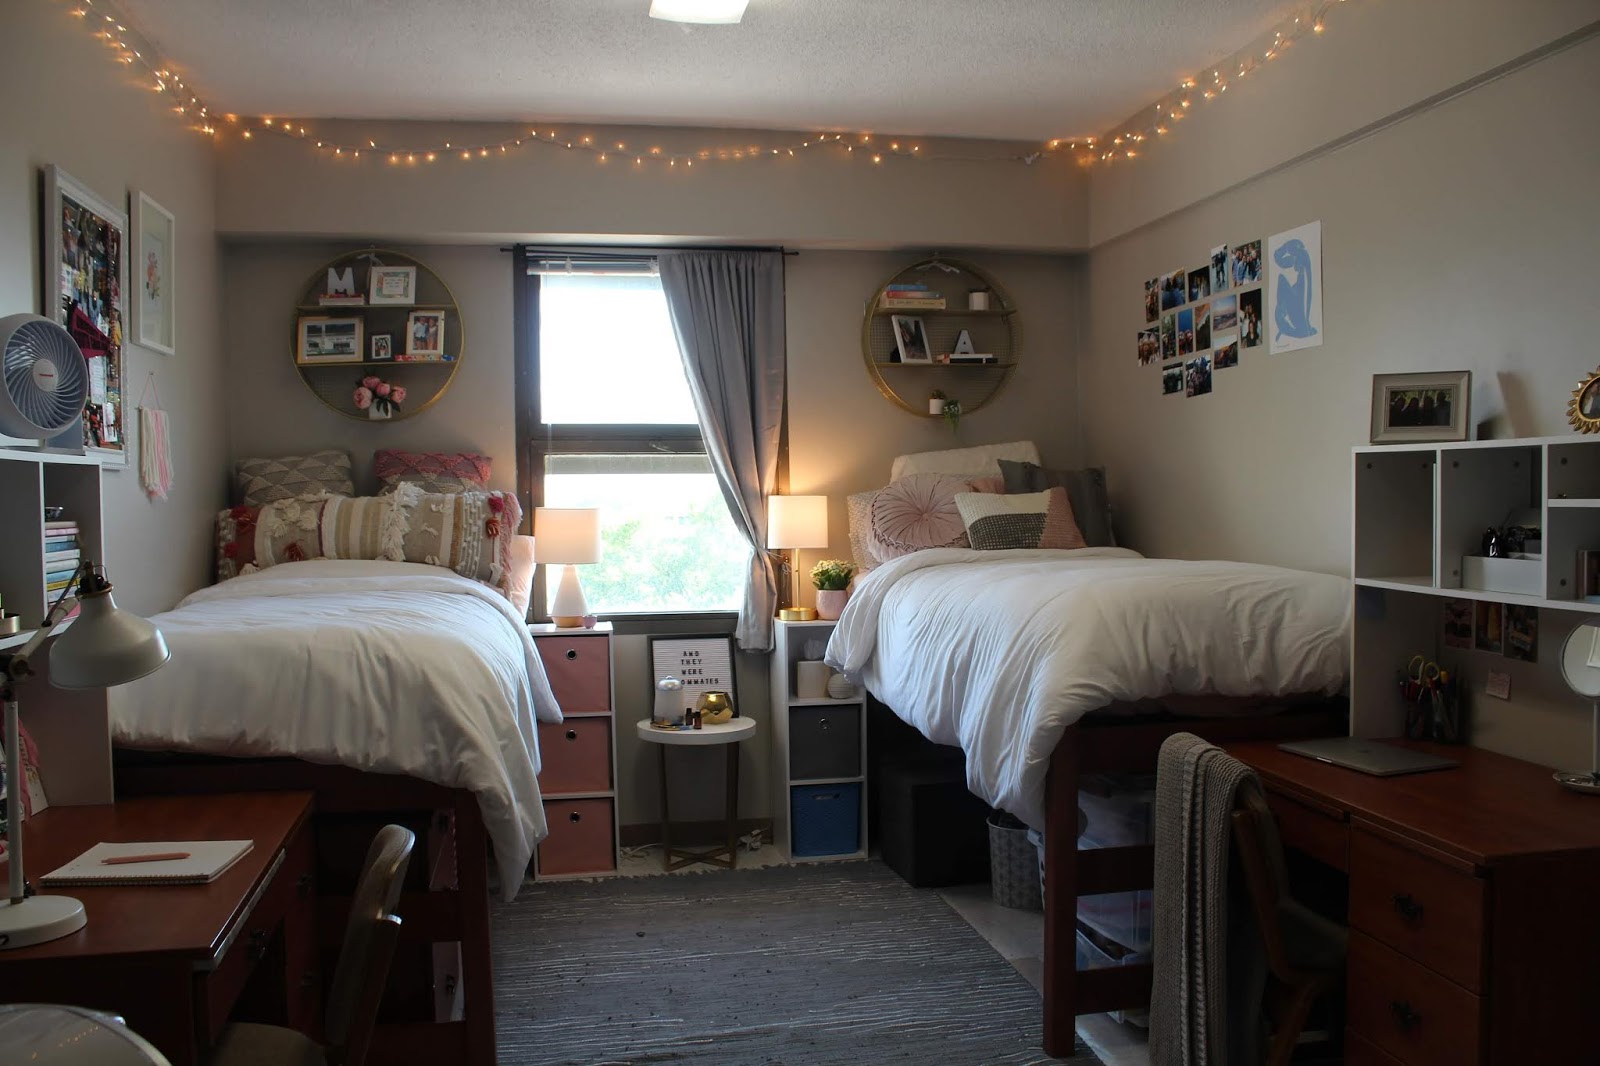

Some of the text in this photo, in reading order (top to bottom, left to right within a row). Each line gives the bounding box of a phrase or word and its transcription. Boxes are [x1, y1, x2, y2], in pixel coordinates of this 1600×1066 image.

[327, 267, 356, 295] M
[953, 329, 976, 354] A
[680, 658, 703, 666] THEY
[680, 677, 719, 685] OMMATES
